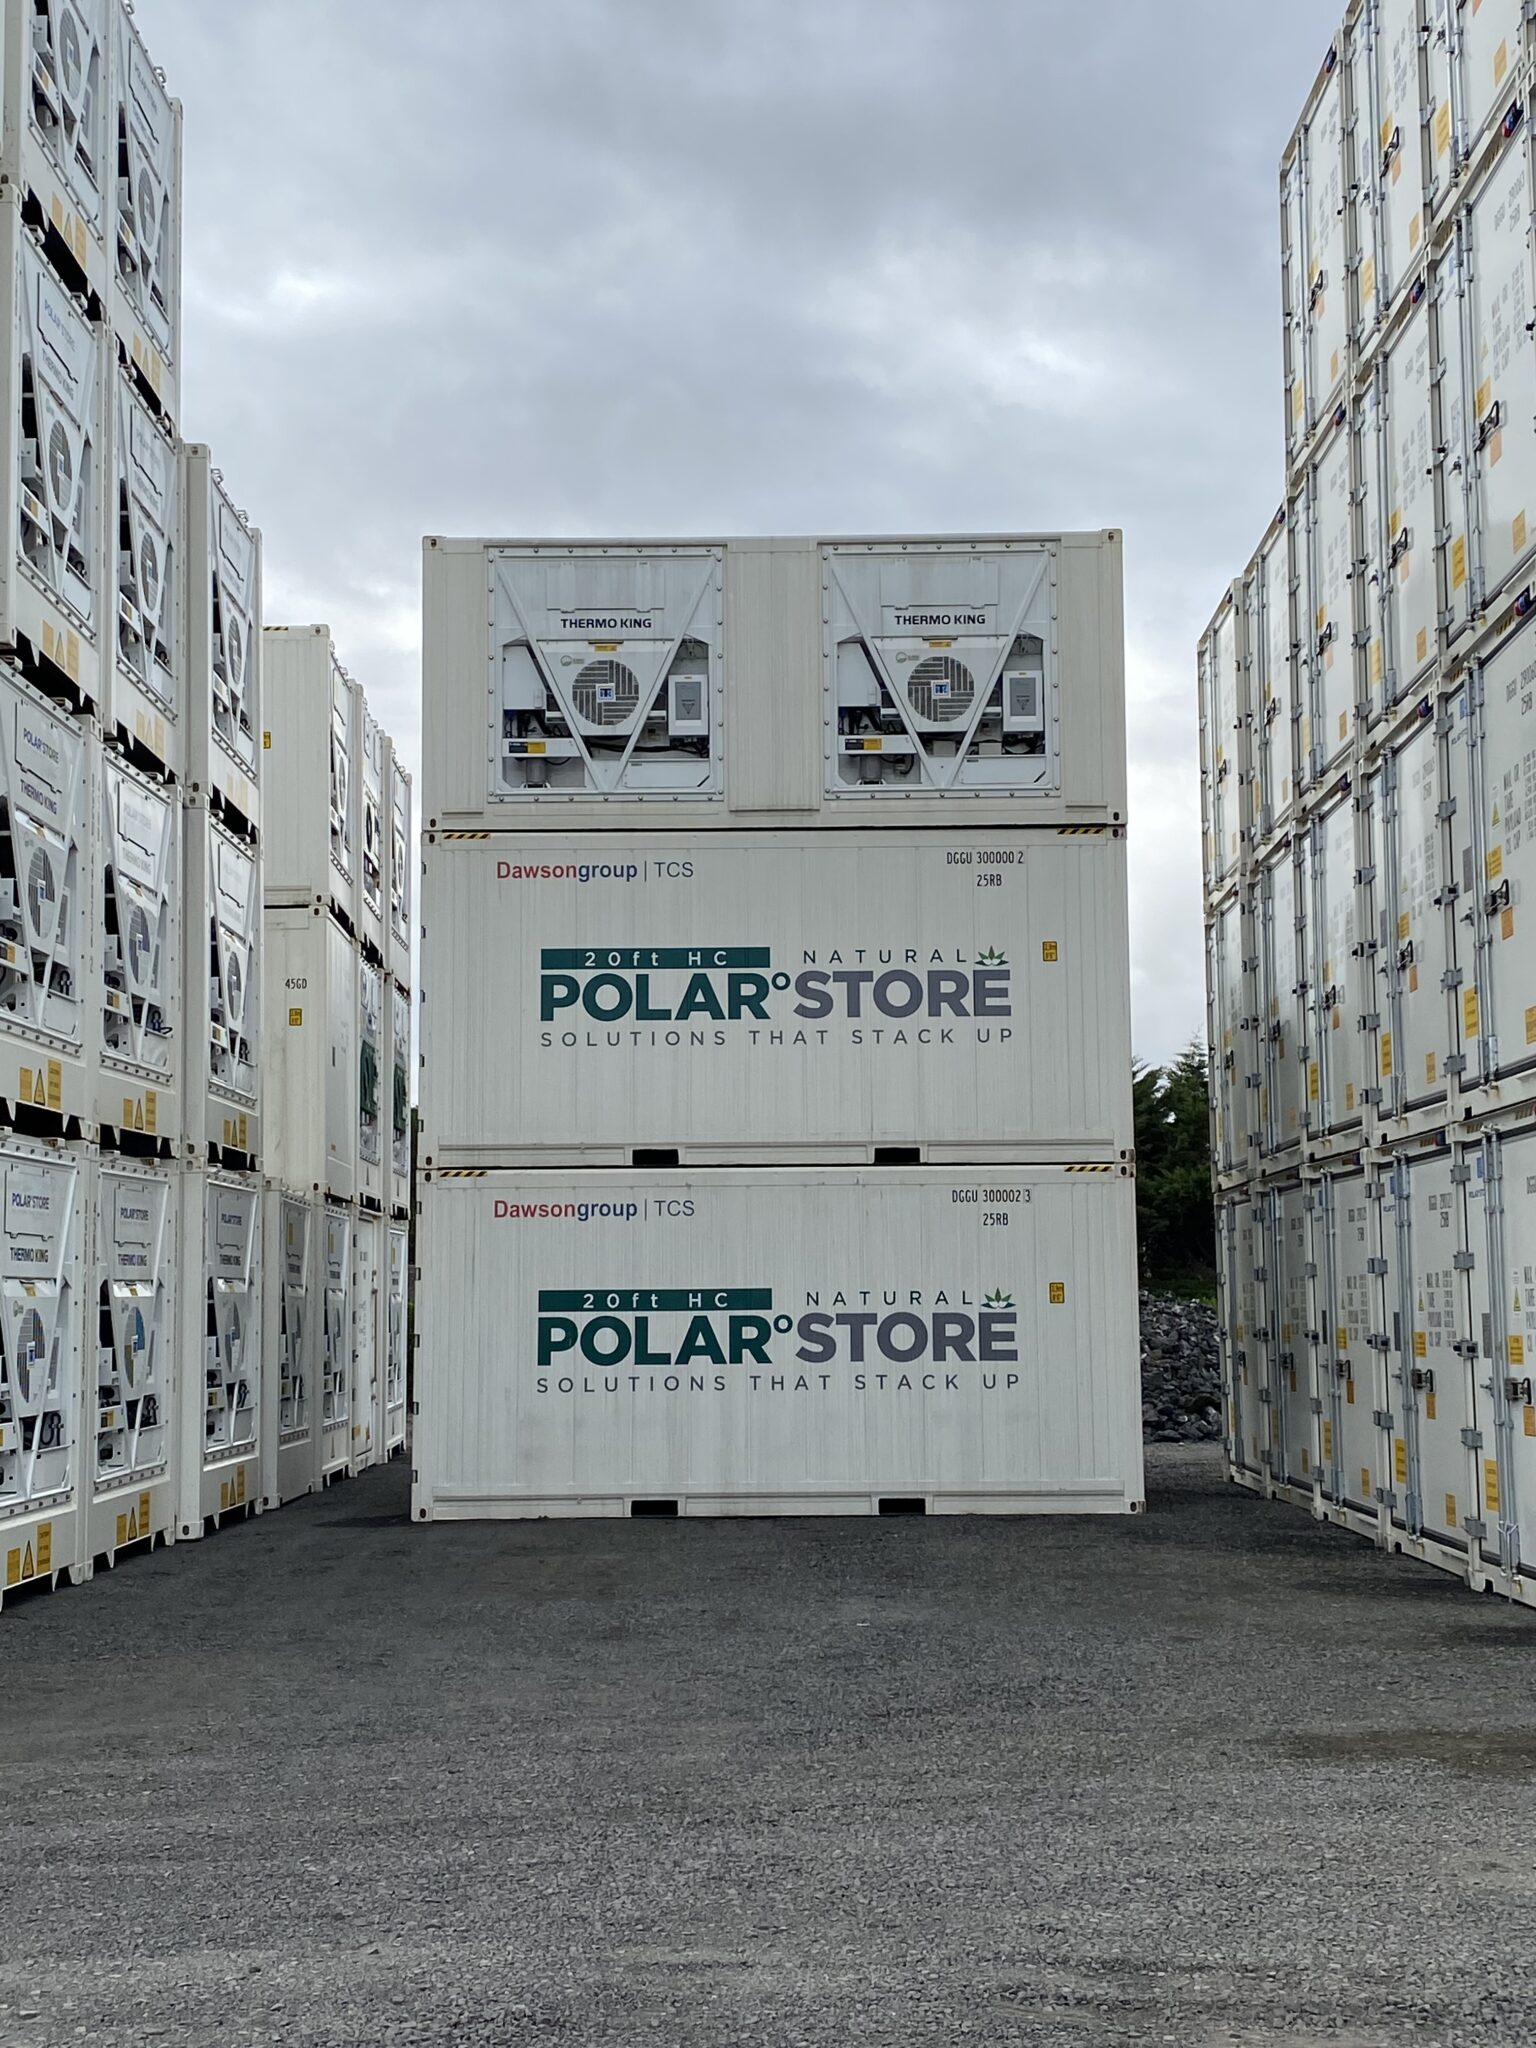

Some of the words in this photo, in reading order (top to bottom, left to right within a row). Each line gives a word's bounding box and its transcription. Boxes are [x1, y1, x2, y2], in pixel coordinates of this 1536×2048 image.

[560, 618, 617, 629] THERMO
[620, 618, 652, 629] KING
[894, 614, 951, 626] THERMO
[954, 614, 986, 625] KING
[946, 851, 972, 864] DGGU
[976, 851, 1014, 864] 300000
[1017, 851, 1025, 864] 2
[496, 861, 638, 882] Dawsongroup
[654, 861, 694, 878] TCS
[977, 873, 1002, 887] 25RB
[584, 951, 659, 967] 20ft
[688, 951, 728, 966] HC
[803, 949, 967, 964] NATURAL
[285, 978, 307, 990] 45GD
[541, 1031, 726, 1047] SOLUTIONS
[748, 1029, 828, 1046] THAT
[851, 1028, 954, 1044] STACK
[977, 1028, 1012, 1043] UP
[952, 1189, 978, 1203] DGGU
[982, 1189, 1021, 1203] 300002
[1025, 1189, 1032, 1203] 3
[493, 1200, 638, 1221] Dawsongroup
[654, 1200, 695, 1217] TCS
[983, 1212, 1009, 1226] 25RB
[583, 1292, 659, 1309] 20ft
[688, 1292, 729, 1308] HC
[806, 1290, 973, 1306] NATURAL
[536, 1376, 726, 1393] SOLUTIONS
[749, 1374, 831, 1391] THAT
[854, 1373, 959, 1391] STACK
[983, 1373, 1019, 1389] UP
